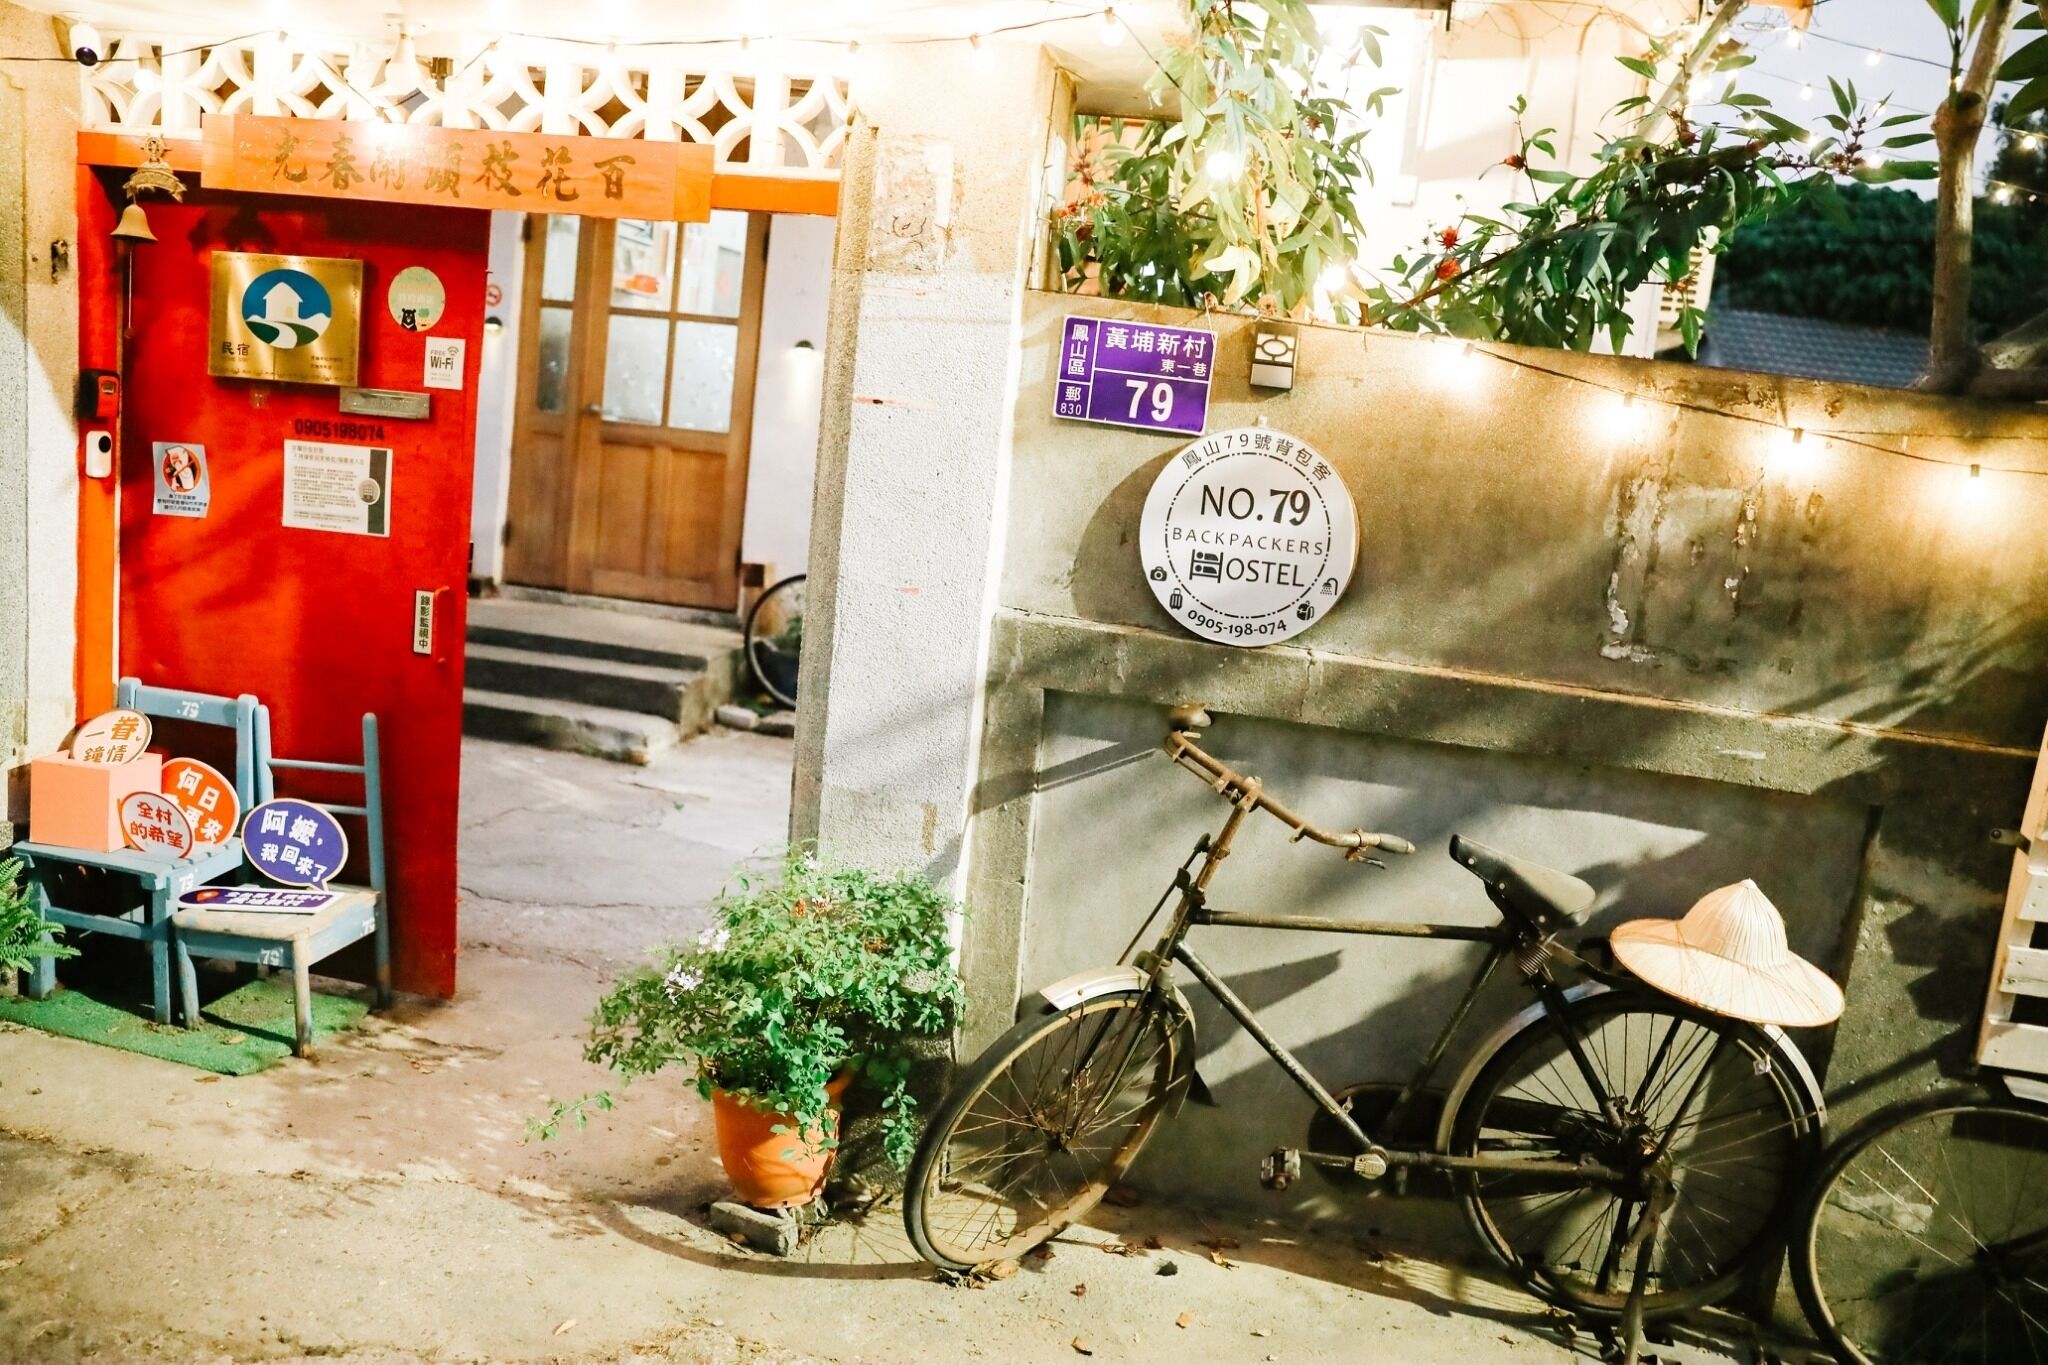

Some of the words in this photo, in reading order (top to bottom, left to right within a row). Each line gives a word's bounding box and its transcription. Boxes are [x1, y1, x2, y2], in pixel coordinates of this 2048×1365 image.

[221, 341, 251, 356] 民宿
[1067, 323, 1089, 376] 鳳山區
[1105, 326, 1207, 359] 黃埔新村
[430, 356, 454, 370] Wi-Fi
[1160, 358, 1207, 377] 東一巷
[1065, 386, 1081, 402] 郵
[1126, 379, 1174, 422] 79
[1060, 402, 1082, 416] 830
[294, 418, 385, 441] 0905198074
[1181, 433, 1332, 482] 鳳山79號背包客
[1172, 527, 1324, 556] BACKPACKERS
[418, 595, 431, 649] 錄影監視中
[1187, 609, 1288, 638] 0905-198-074
[176, 766, 221, 812] 何日
[136, 801, 172, 826] 全村
[130, 820, 184, 849] 的希望
[260, 842, 328, 883] 我回來了
